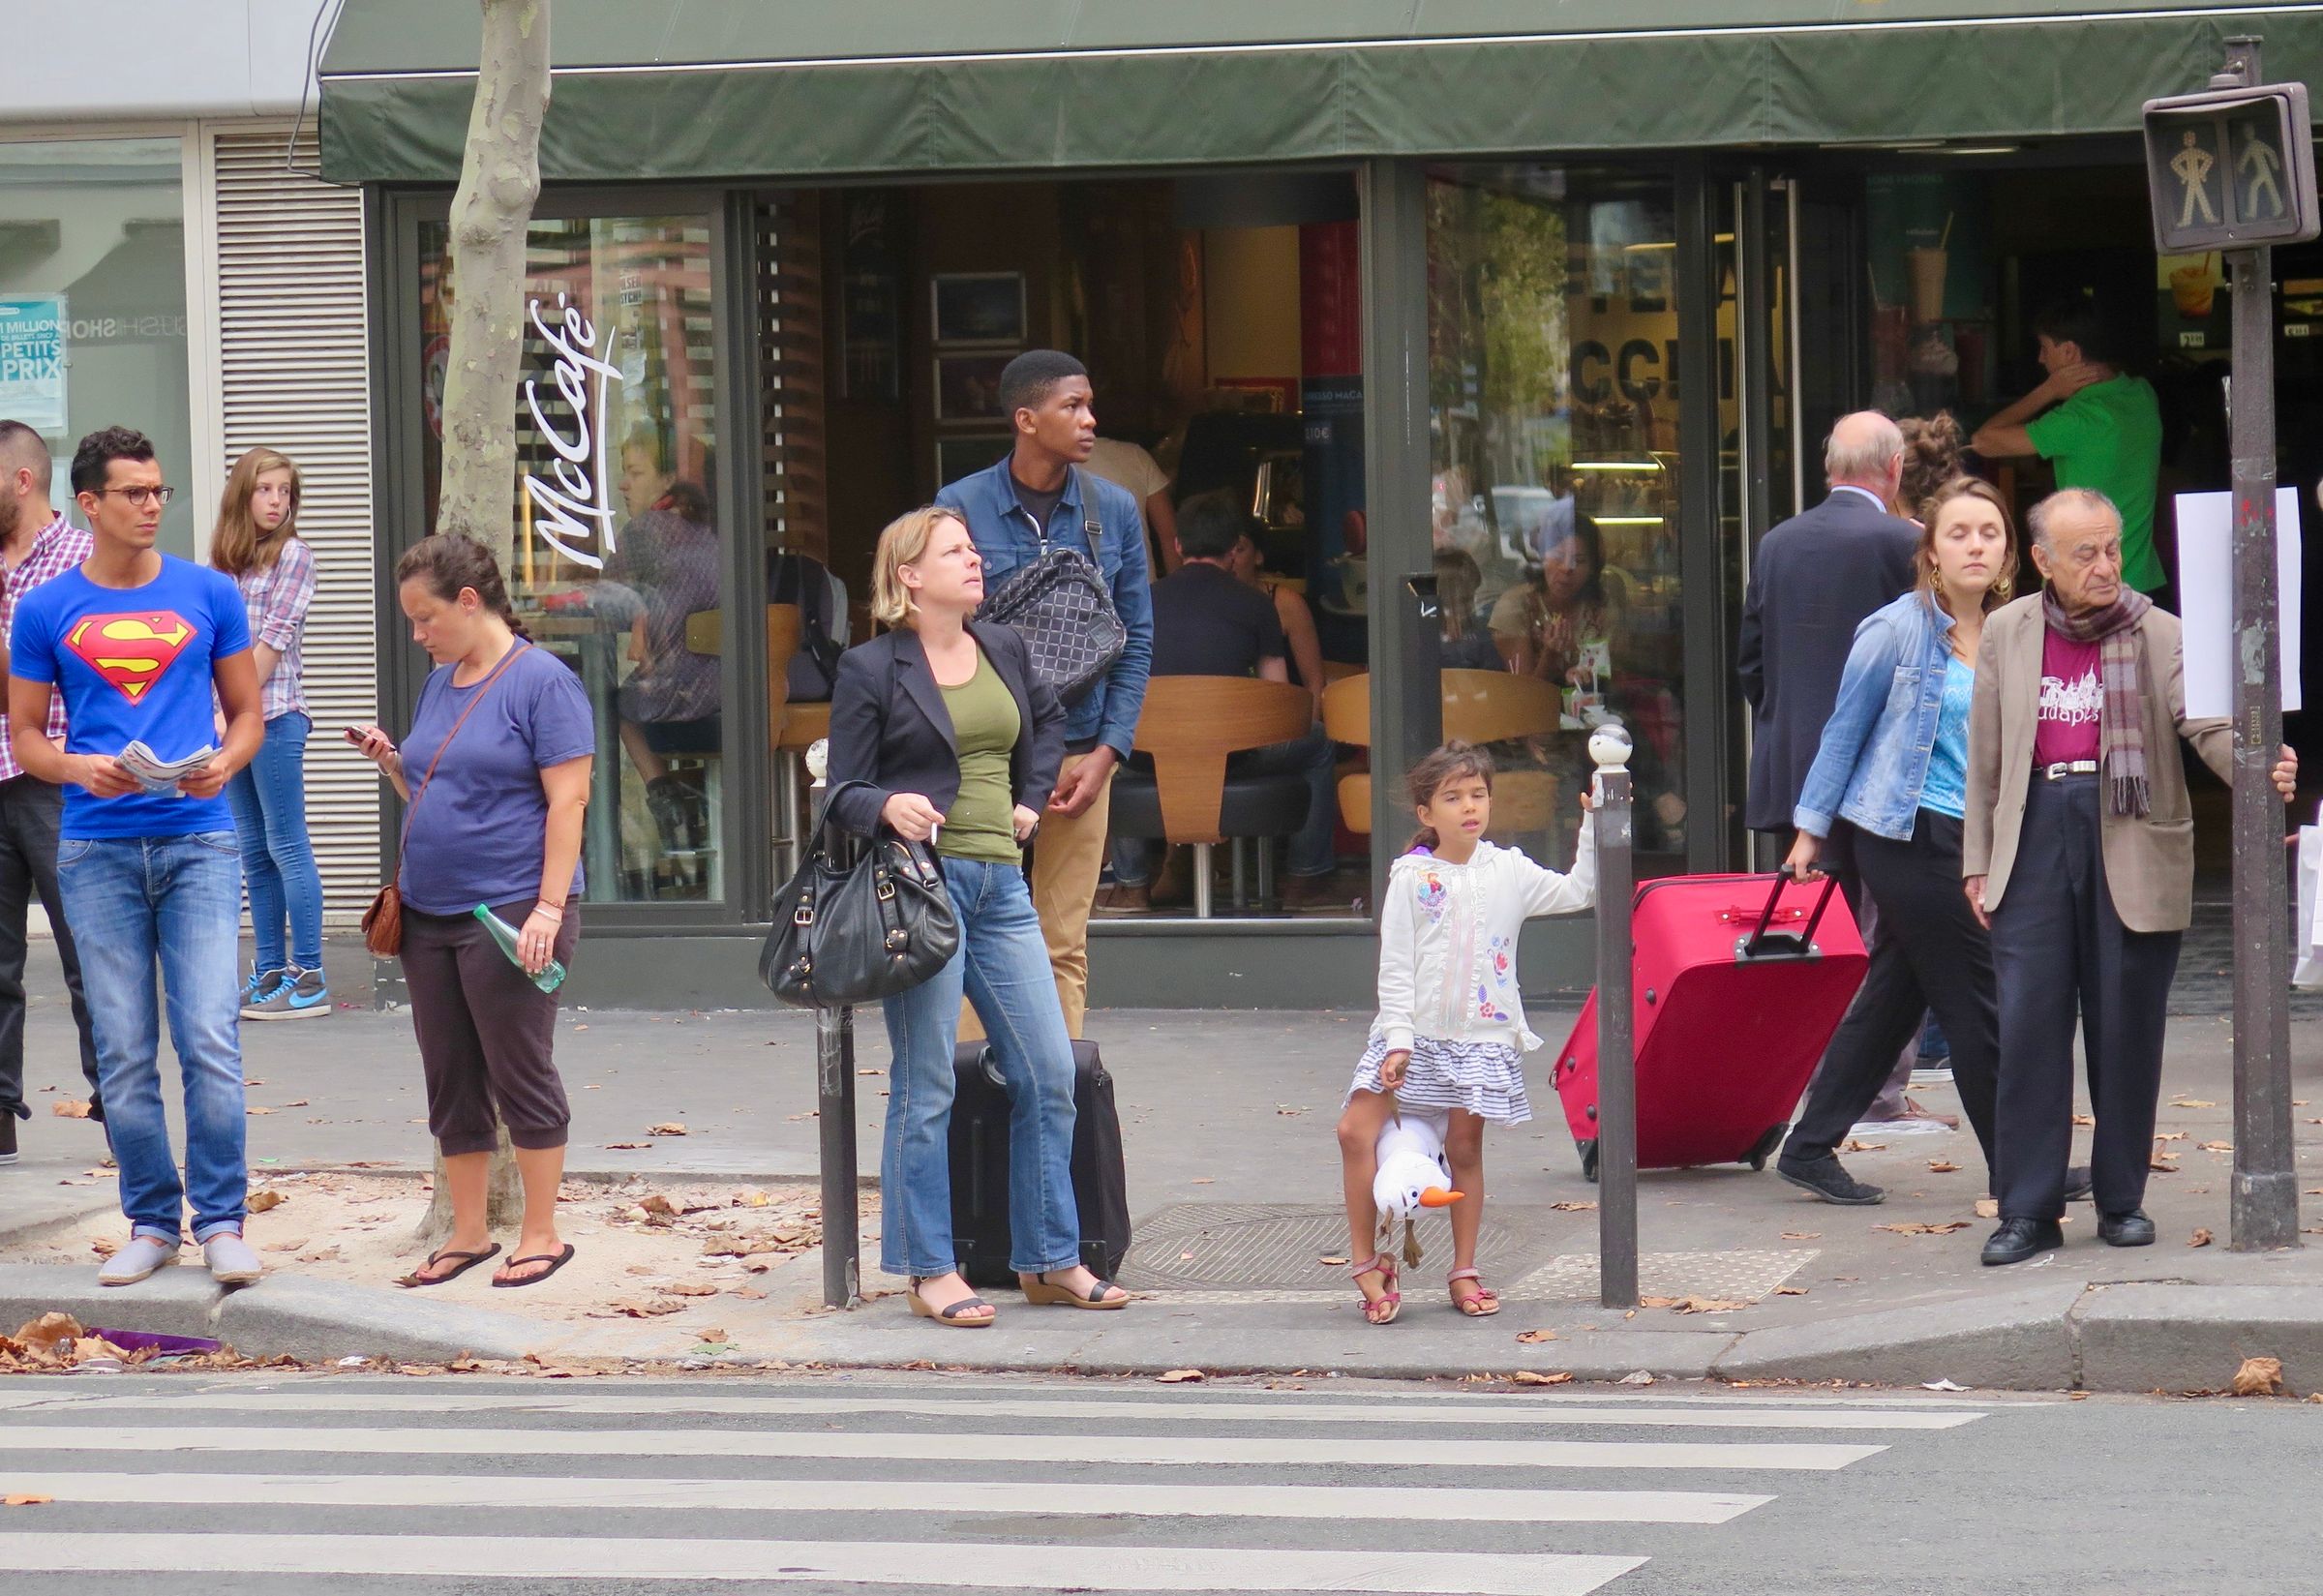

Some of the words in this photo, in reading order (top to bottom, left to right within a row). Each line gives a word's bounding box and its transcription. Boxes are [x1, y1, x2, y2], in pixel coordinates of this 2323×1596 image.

[7, 319, 61, 333] MILLION
[2, 340, 62, 358] PETITS
[3, 357, 63, 381] PRIX
[524, 291, 622, 569] McCafé
